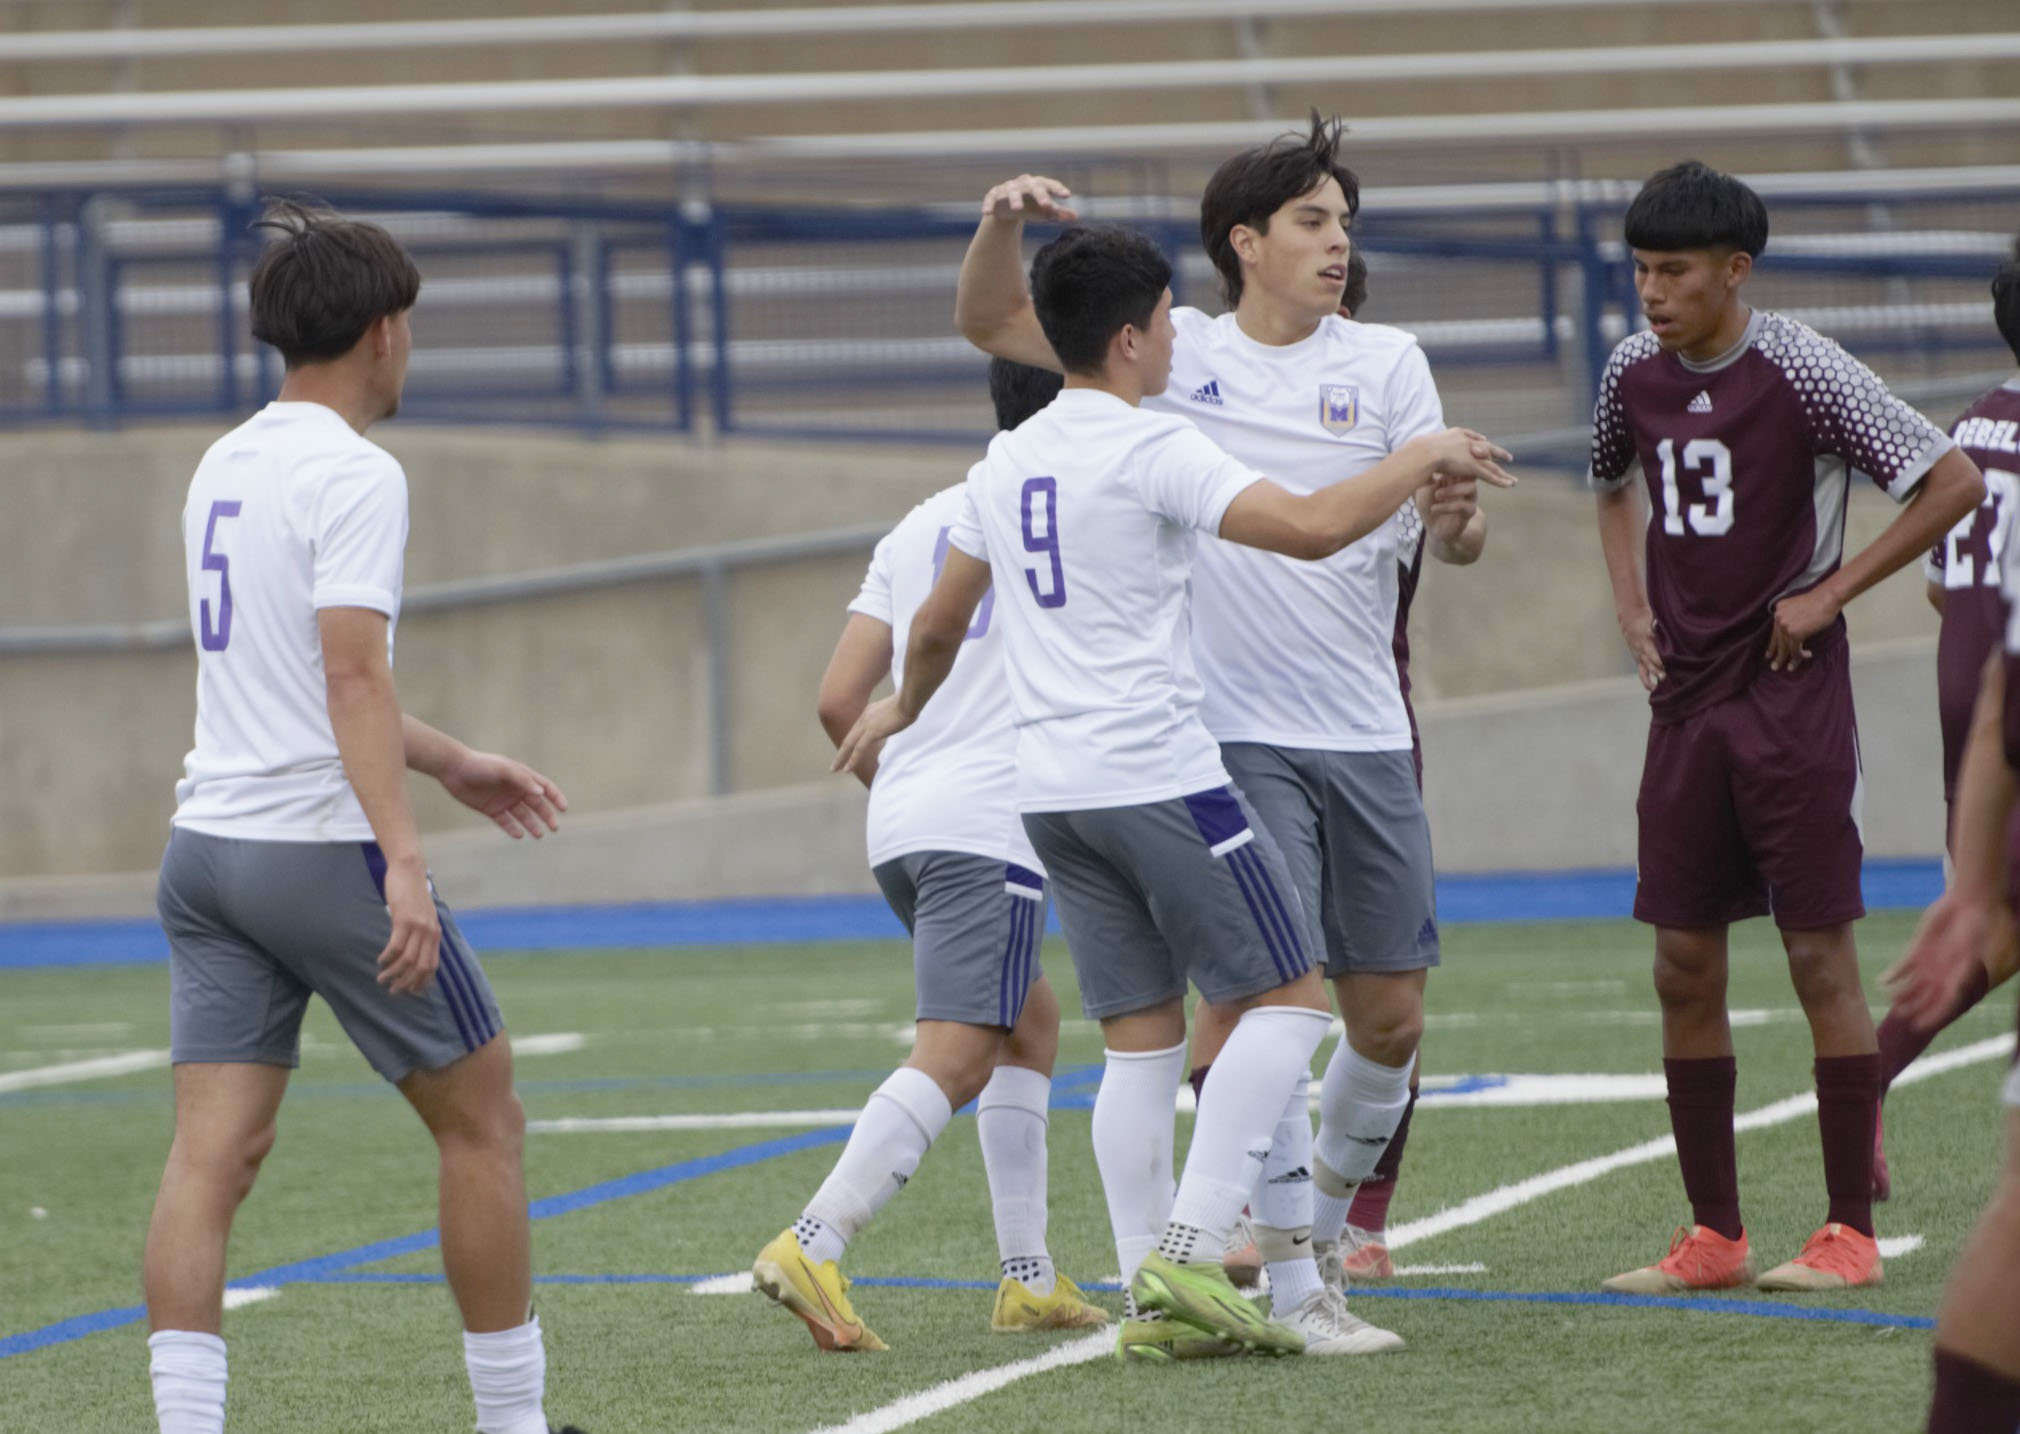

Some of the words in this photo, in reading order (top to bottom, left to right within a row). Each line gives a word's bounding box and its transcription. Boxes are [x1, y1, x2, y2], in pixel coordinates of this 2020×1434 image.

[1190, 391, 1223, 406] adidas
[1330, 406, 1349, 422] M
[1952, 416, 2020, 453] REBEL
[1656, 438, 1735, 536] 13
[200, 500, 243, 651] 5
[1021, 476, 1067, 608] 9
